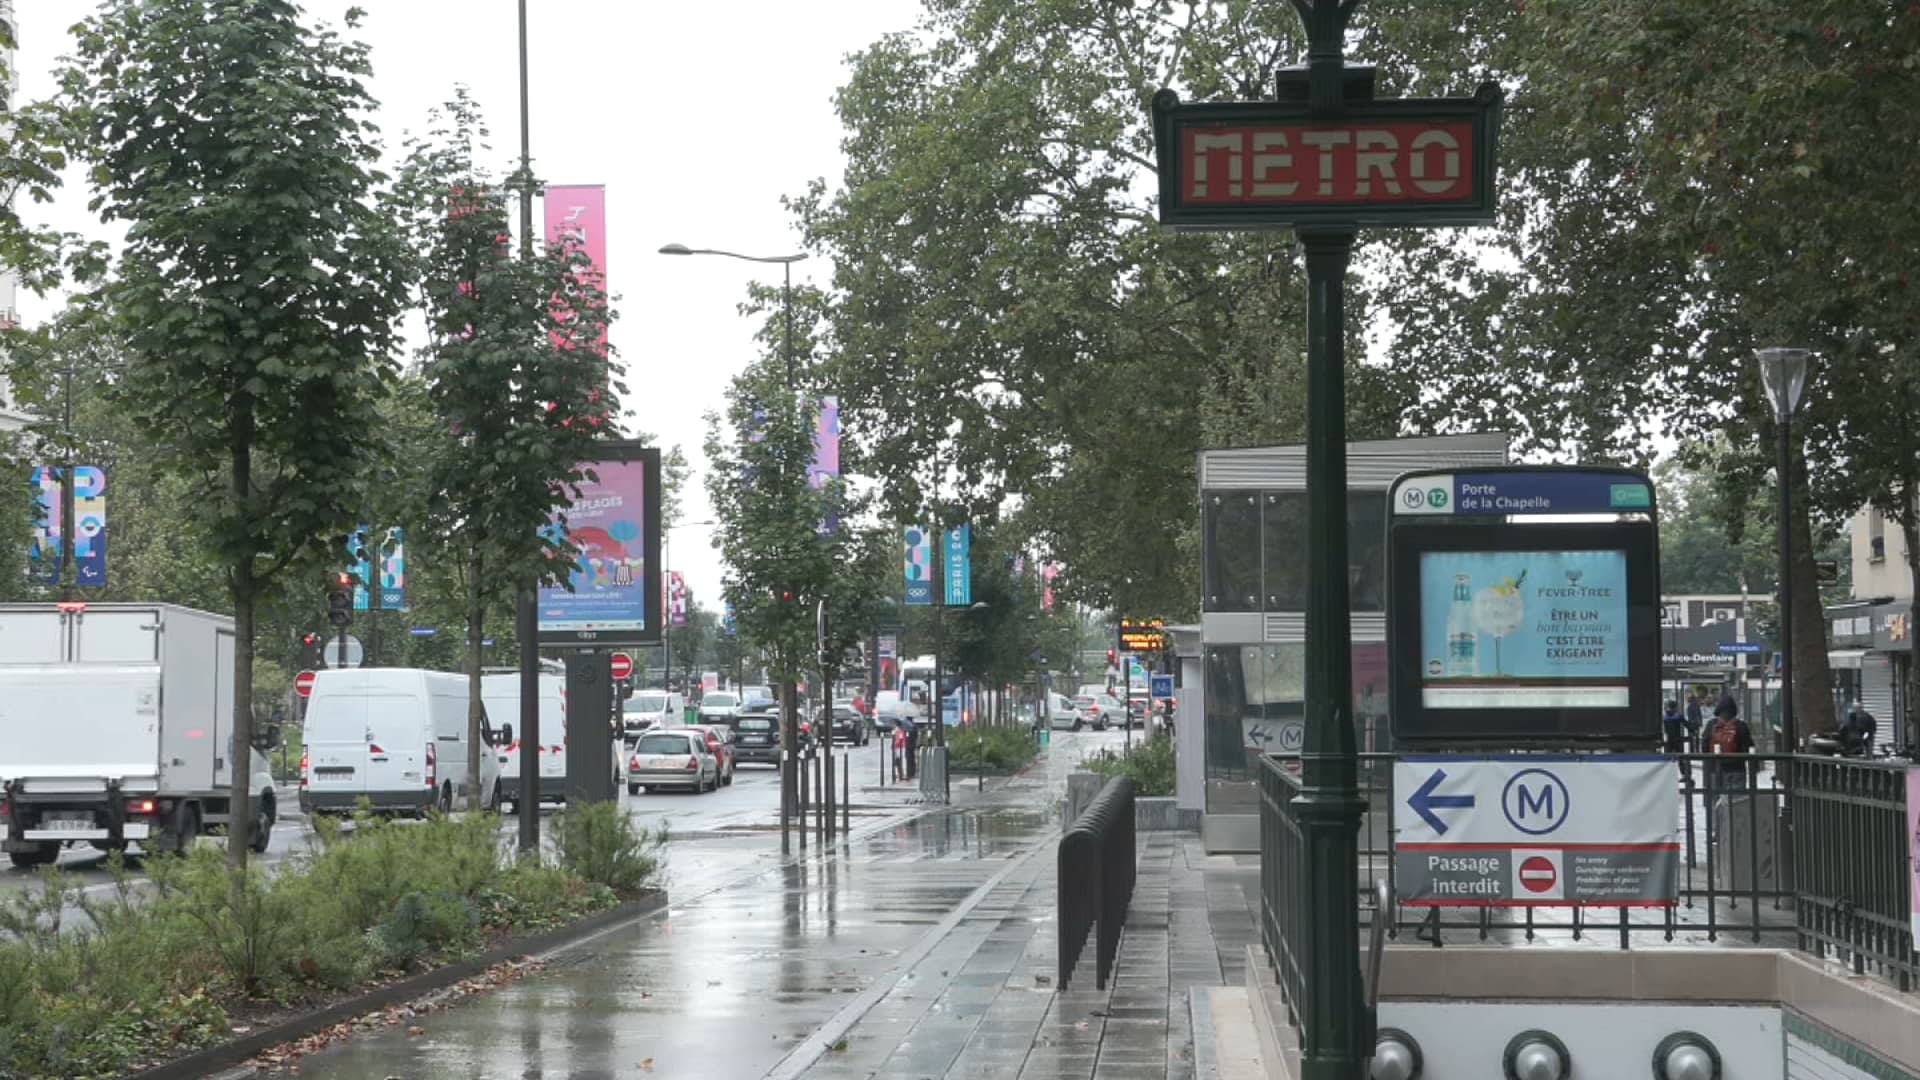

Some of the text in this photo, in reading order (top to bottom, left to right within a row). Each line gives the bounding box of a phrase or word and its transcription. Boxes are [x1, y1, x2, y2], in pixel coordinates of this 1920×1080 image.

[1192, 130, 1461, 198] METRO
[1462, 484, 1496, 496] Porte
[1431, 492, 1446, 505] 12
[1462, 497, 1550, 511] de la Chapelle
[1537, 587, 1612, 598] FEVER-TREE
[1551, 608, 1599, 621] ÊTRE UN
[1546, 635, 1575, 646] C'EST
[1546, 647, 1605, 659] EXIGEANT
[1661, 652, 1735, 663] édico-Dentaire
[1428, 856, 1500, 875] Passage
[1433, 877, 1501, 895] interdit
